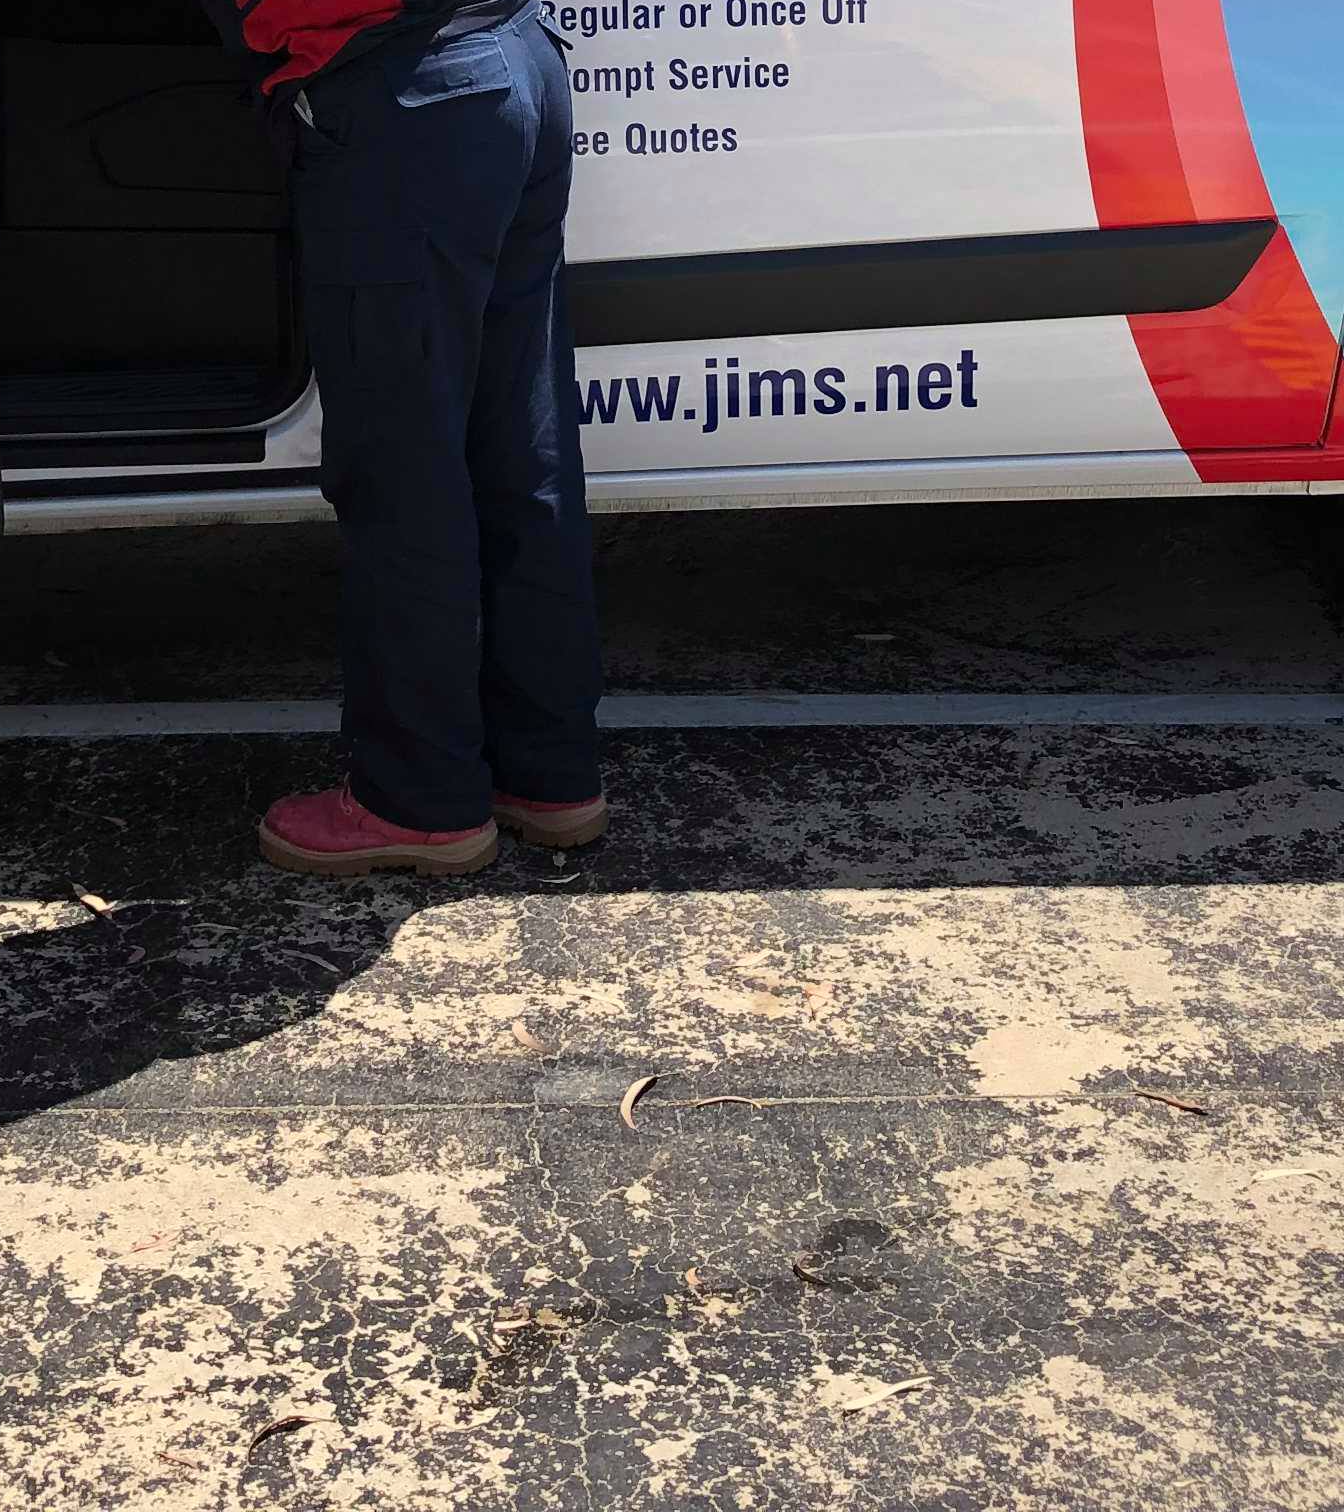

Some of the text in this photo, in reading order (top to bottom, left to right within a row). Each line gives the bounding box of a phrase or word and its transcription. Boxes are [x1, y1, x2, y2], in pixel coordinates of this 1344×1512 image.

[679, 3, 712, 29] or
[668, 56, 791, 90] Service
[625, 122, 738, 156] Quotes
[576, 349, 979, 434] ww.jims.net
